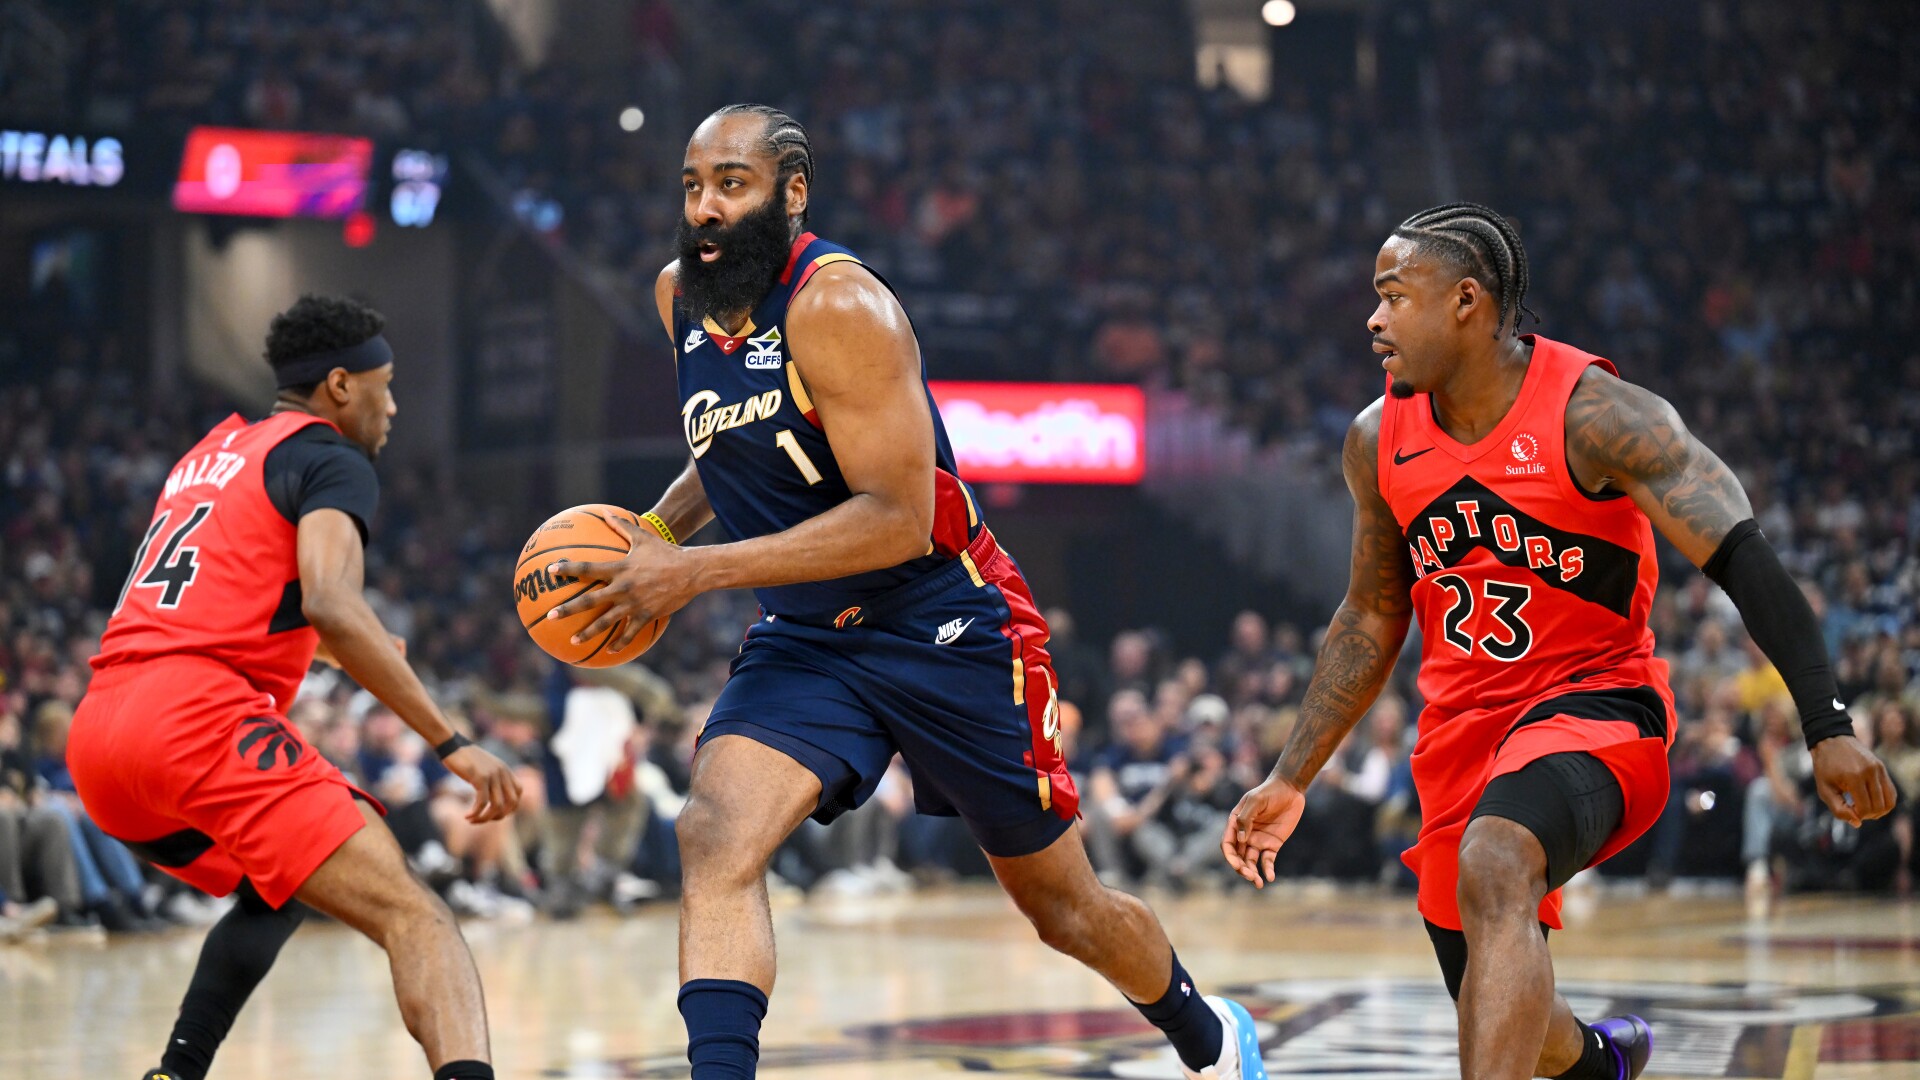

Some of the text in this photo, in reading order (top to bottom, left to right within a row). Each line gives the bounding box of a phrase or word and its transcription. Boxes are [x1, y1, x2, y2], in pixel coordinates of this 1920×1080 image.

[0, 130, 124, 187] TEALS
[747, 354, 781, 366] CLIFFS
[681, 389, 782, 460] CLEVELAND
[165, 451, 246, 500] WALTER
[775, 429, 824, 486] 1
[1505, 462, 1547, 475] Sun Life
[1409, 499, 1584, 583] RAPTORS
[937, 617, 963, 641] NIKE
[1431, 573, 1533, 662] 23
